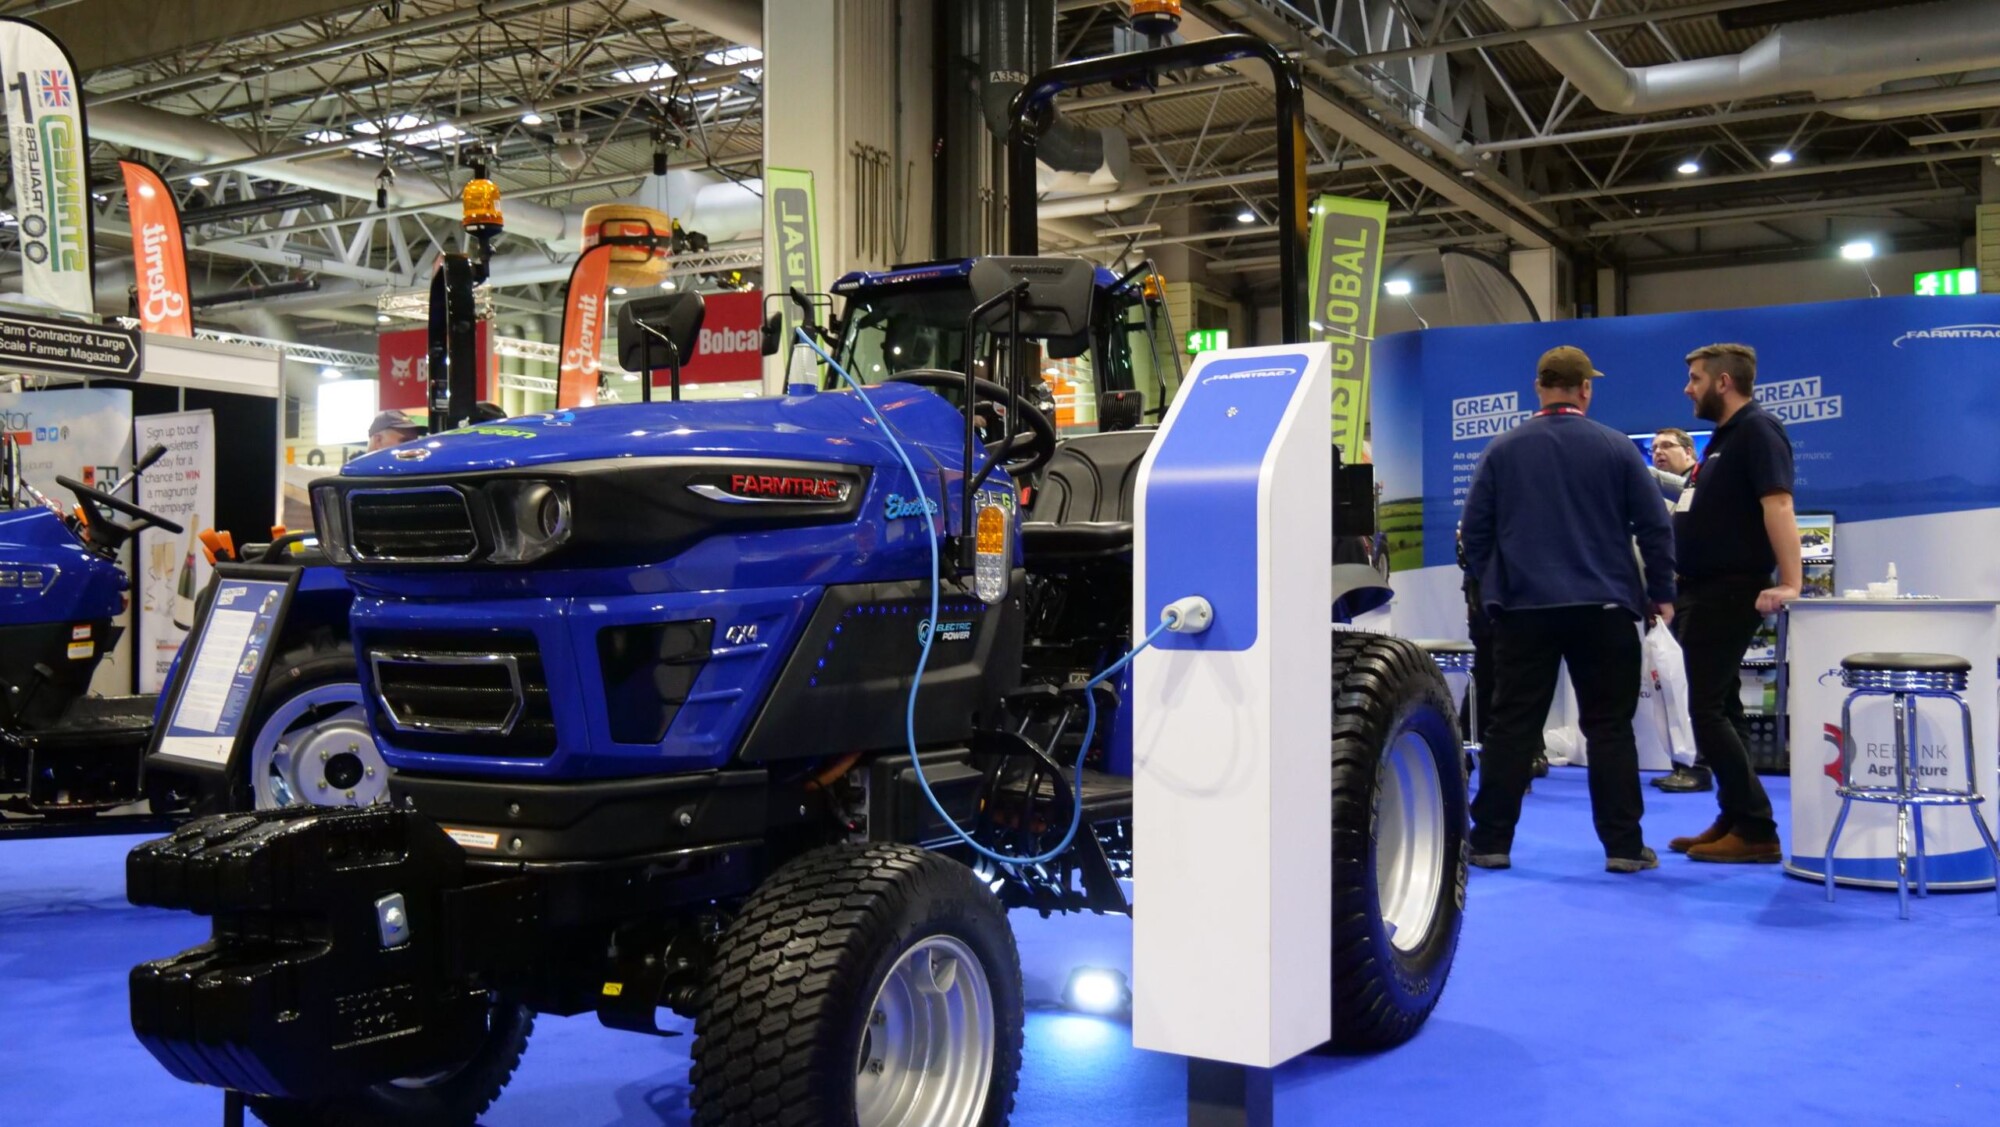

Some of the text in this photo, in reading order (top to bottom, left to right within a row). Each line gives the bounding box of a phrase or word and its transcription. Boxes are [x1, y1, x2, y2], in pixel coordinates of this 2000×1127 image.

[1324, 228, 1368, 372] GLOBAL
[28, 327, 82, 344] Contractor
[85, 334, 94, 346] &
[96, 336, 125, 351] Large
[566, 294, 598, 375] Eternit
[29, 342, 68, 357] Farmer
[71, 347, 120, 364] Magazine
[1212, 369, 1287, 380] FARMTRAC
[1753, 380, 1818, 403] GREAT
[1455, 395, 1515, 416] GREAT
[1766, 399, 1839, 422] SULTS
[146, 427, 164, 441] Sign
[185, 470, 200, 480] WIN
[731, 474, 839, 497] FARMTRAC
[936, 622, 972, 632] ELECTRIC
[942, 631, 970, 641] POWER
